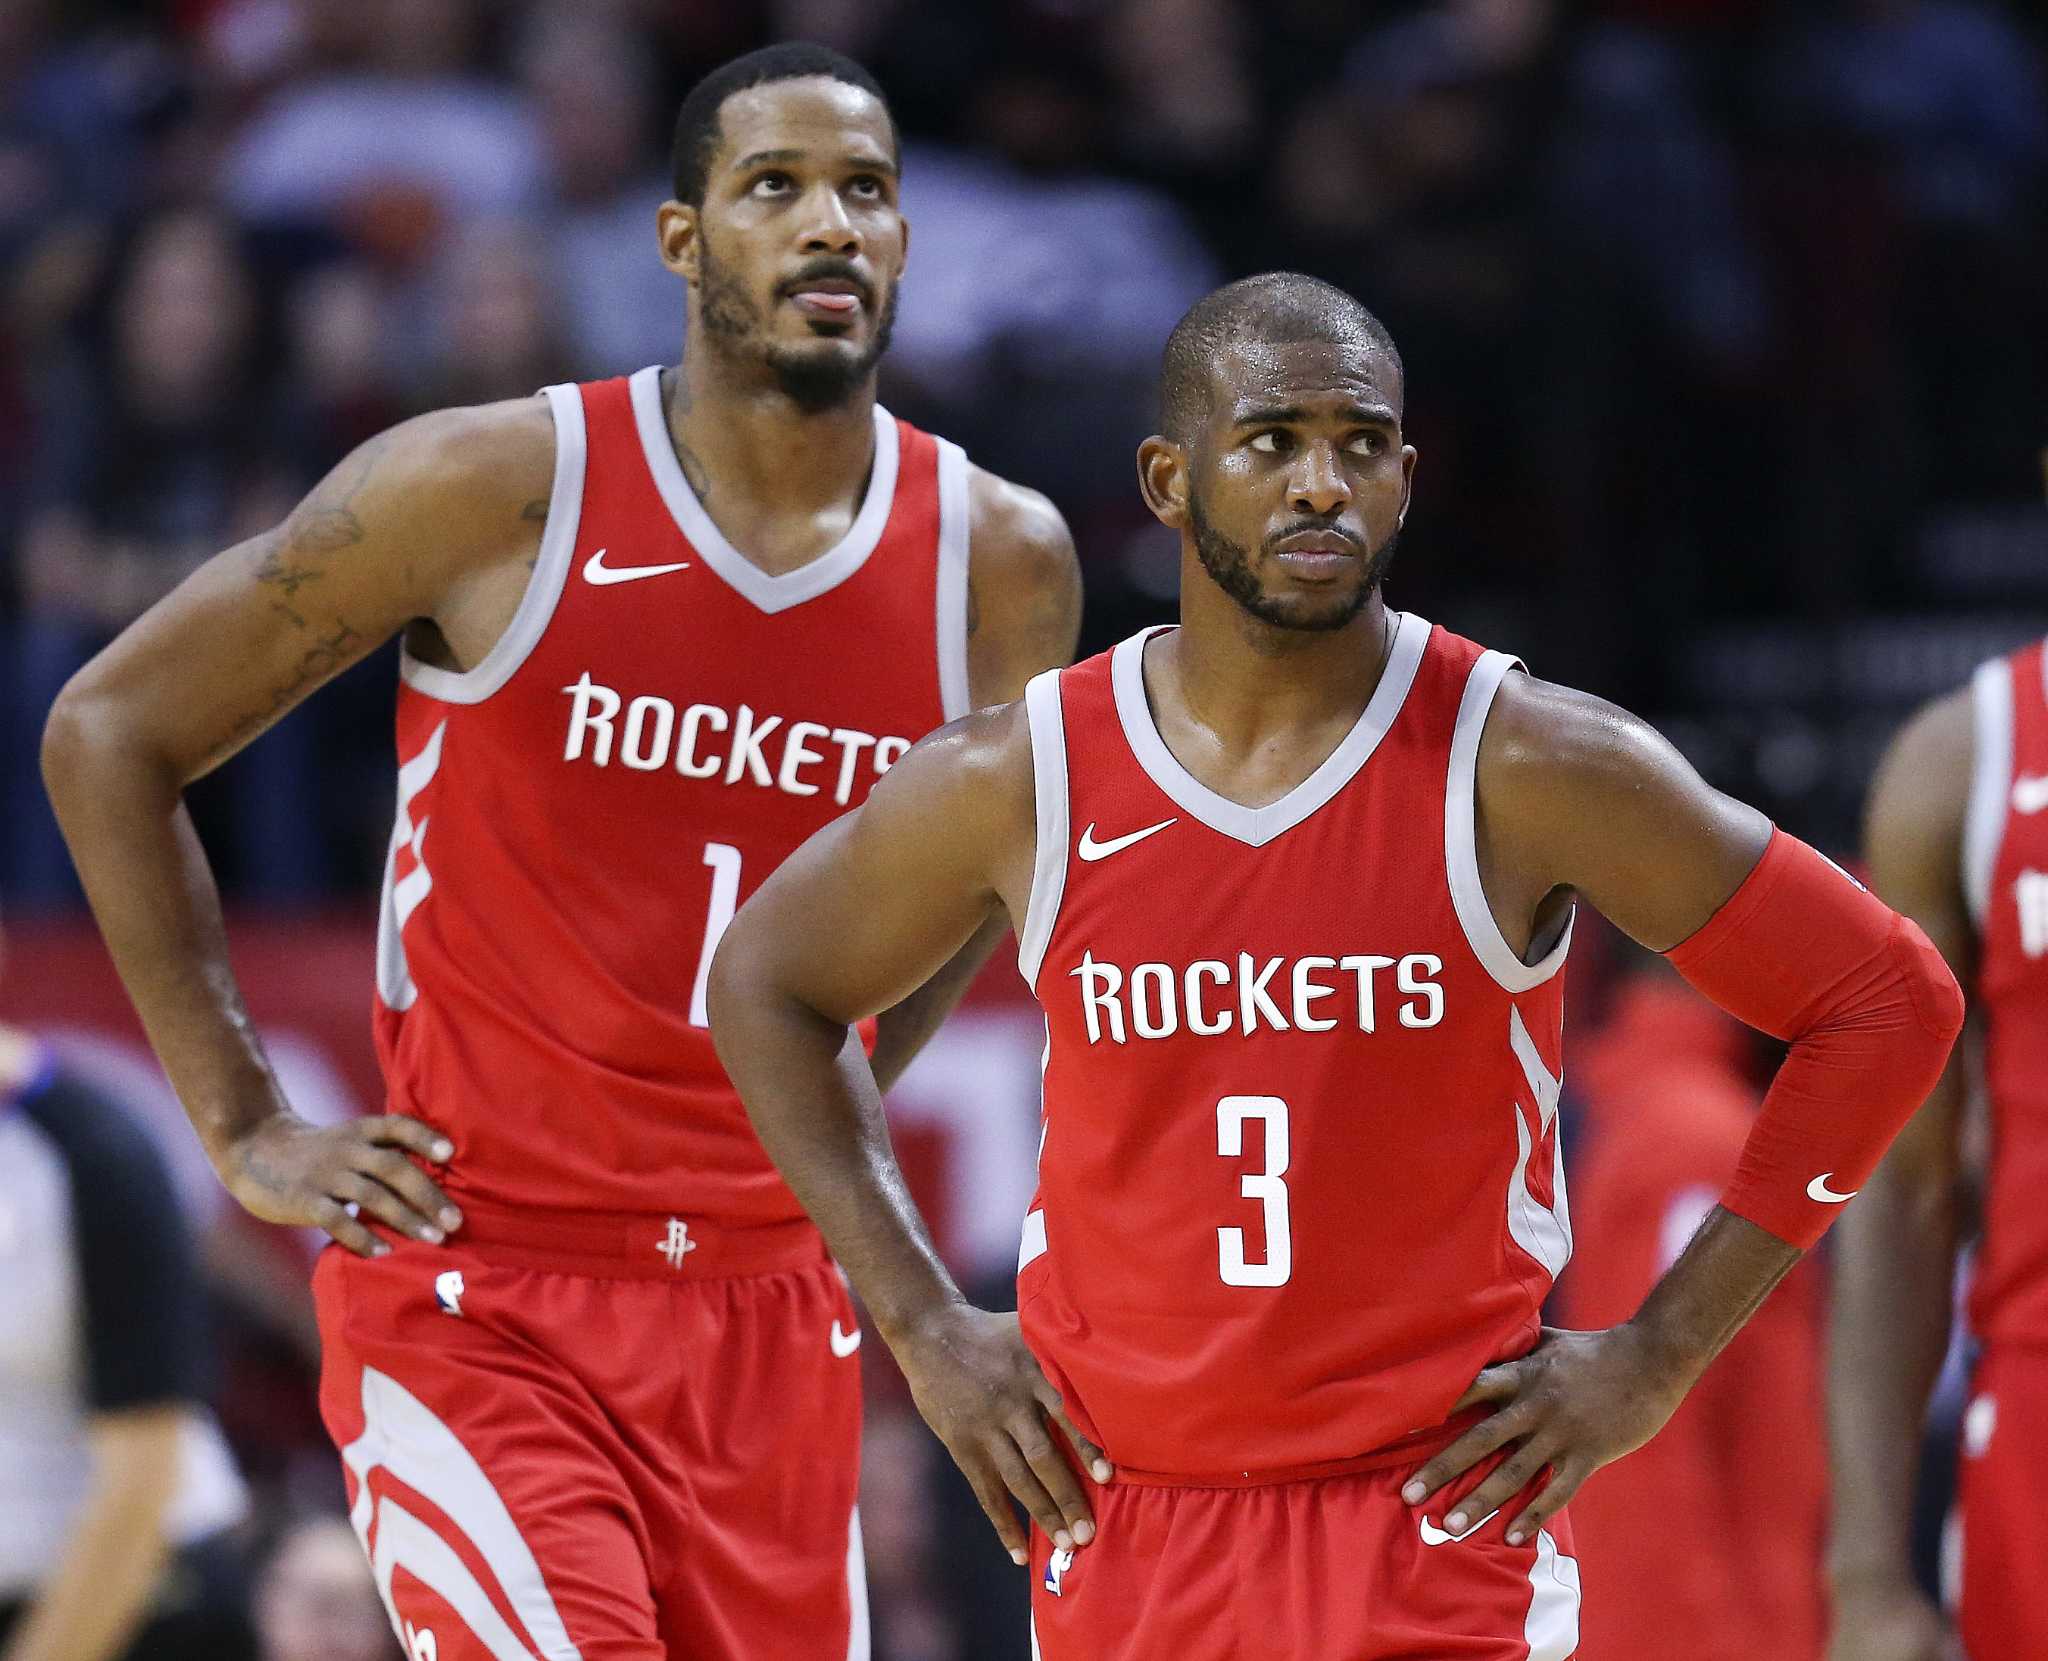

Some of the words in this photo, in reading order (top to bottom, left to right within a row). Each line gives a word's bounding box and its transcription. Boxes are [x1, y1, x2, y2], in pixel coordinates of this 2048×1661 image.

[689, 841, 742, 1029] 1
[1069, 949, 1446, 1045] ROCKETS
[1216, 1095, 1293, 1288] 3
